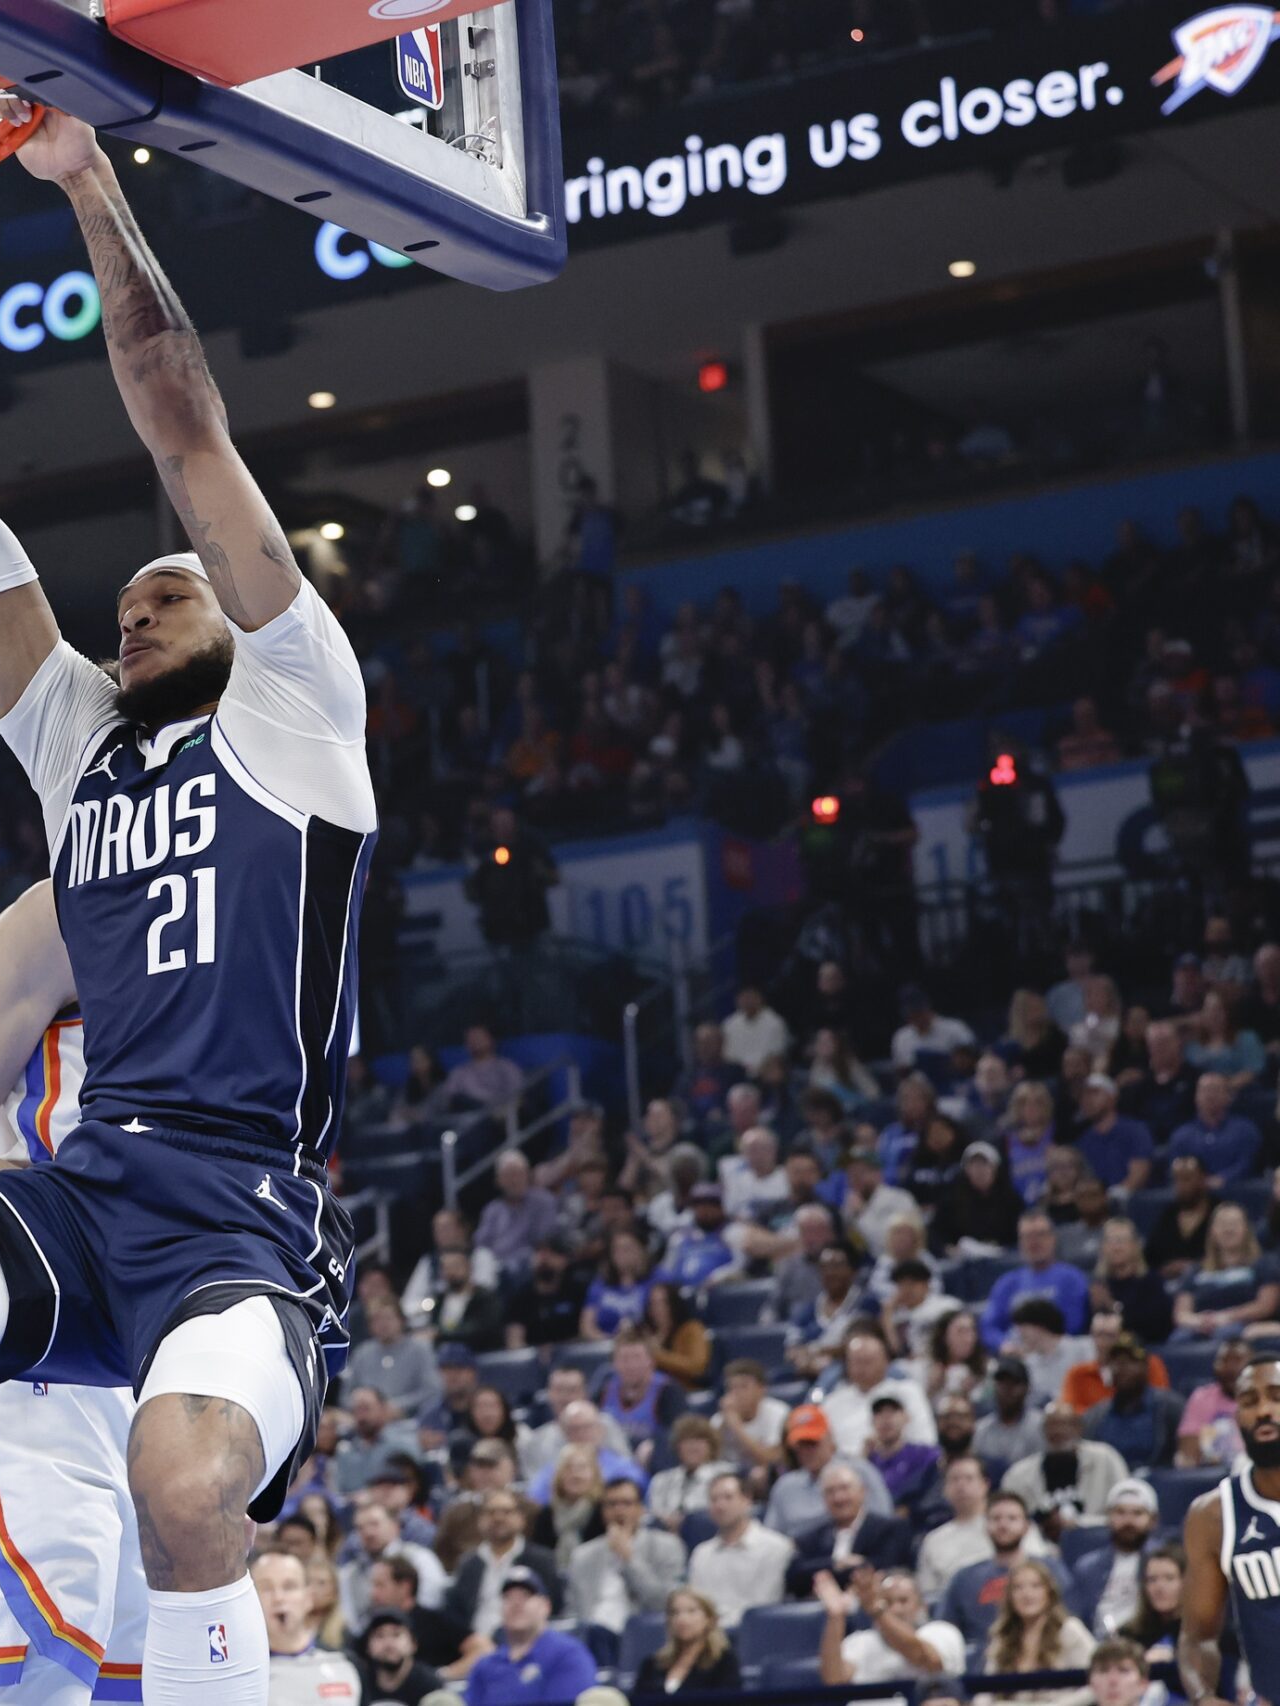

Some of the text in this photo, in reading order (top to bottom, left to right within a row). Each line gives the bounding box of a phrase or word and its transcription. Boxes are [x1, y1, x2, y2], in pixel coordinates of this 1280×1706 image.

[404, 54, 427, 92] NBA
[564, 61, 1124, 224] ringing us closer.
[68, 773, 216, 889] MAVS
[147, 867, 216, 975] 21
